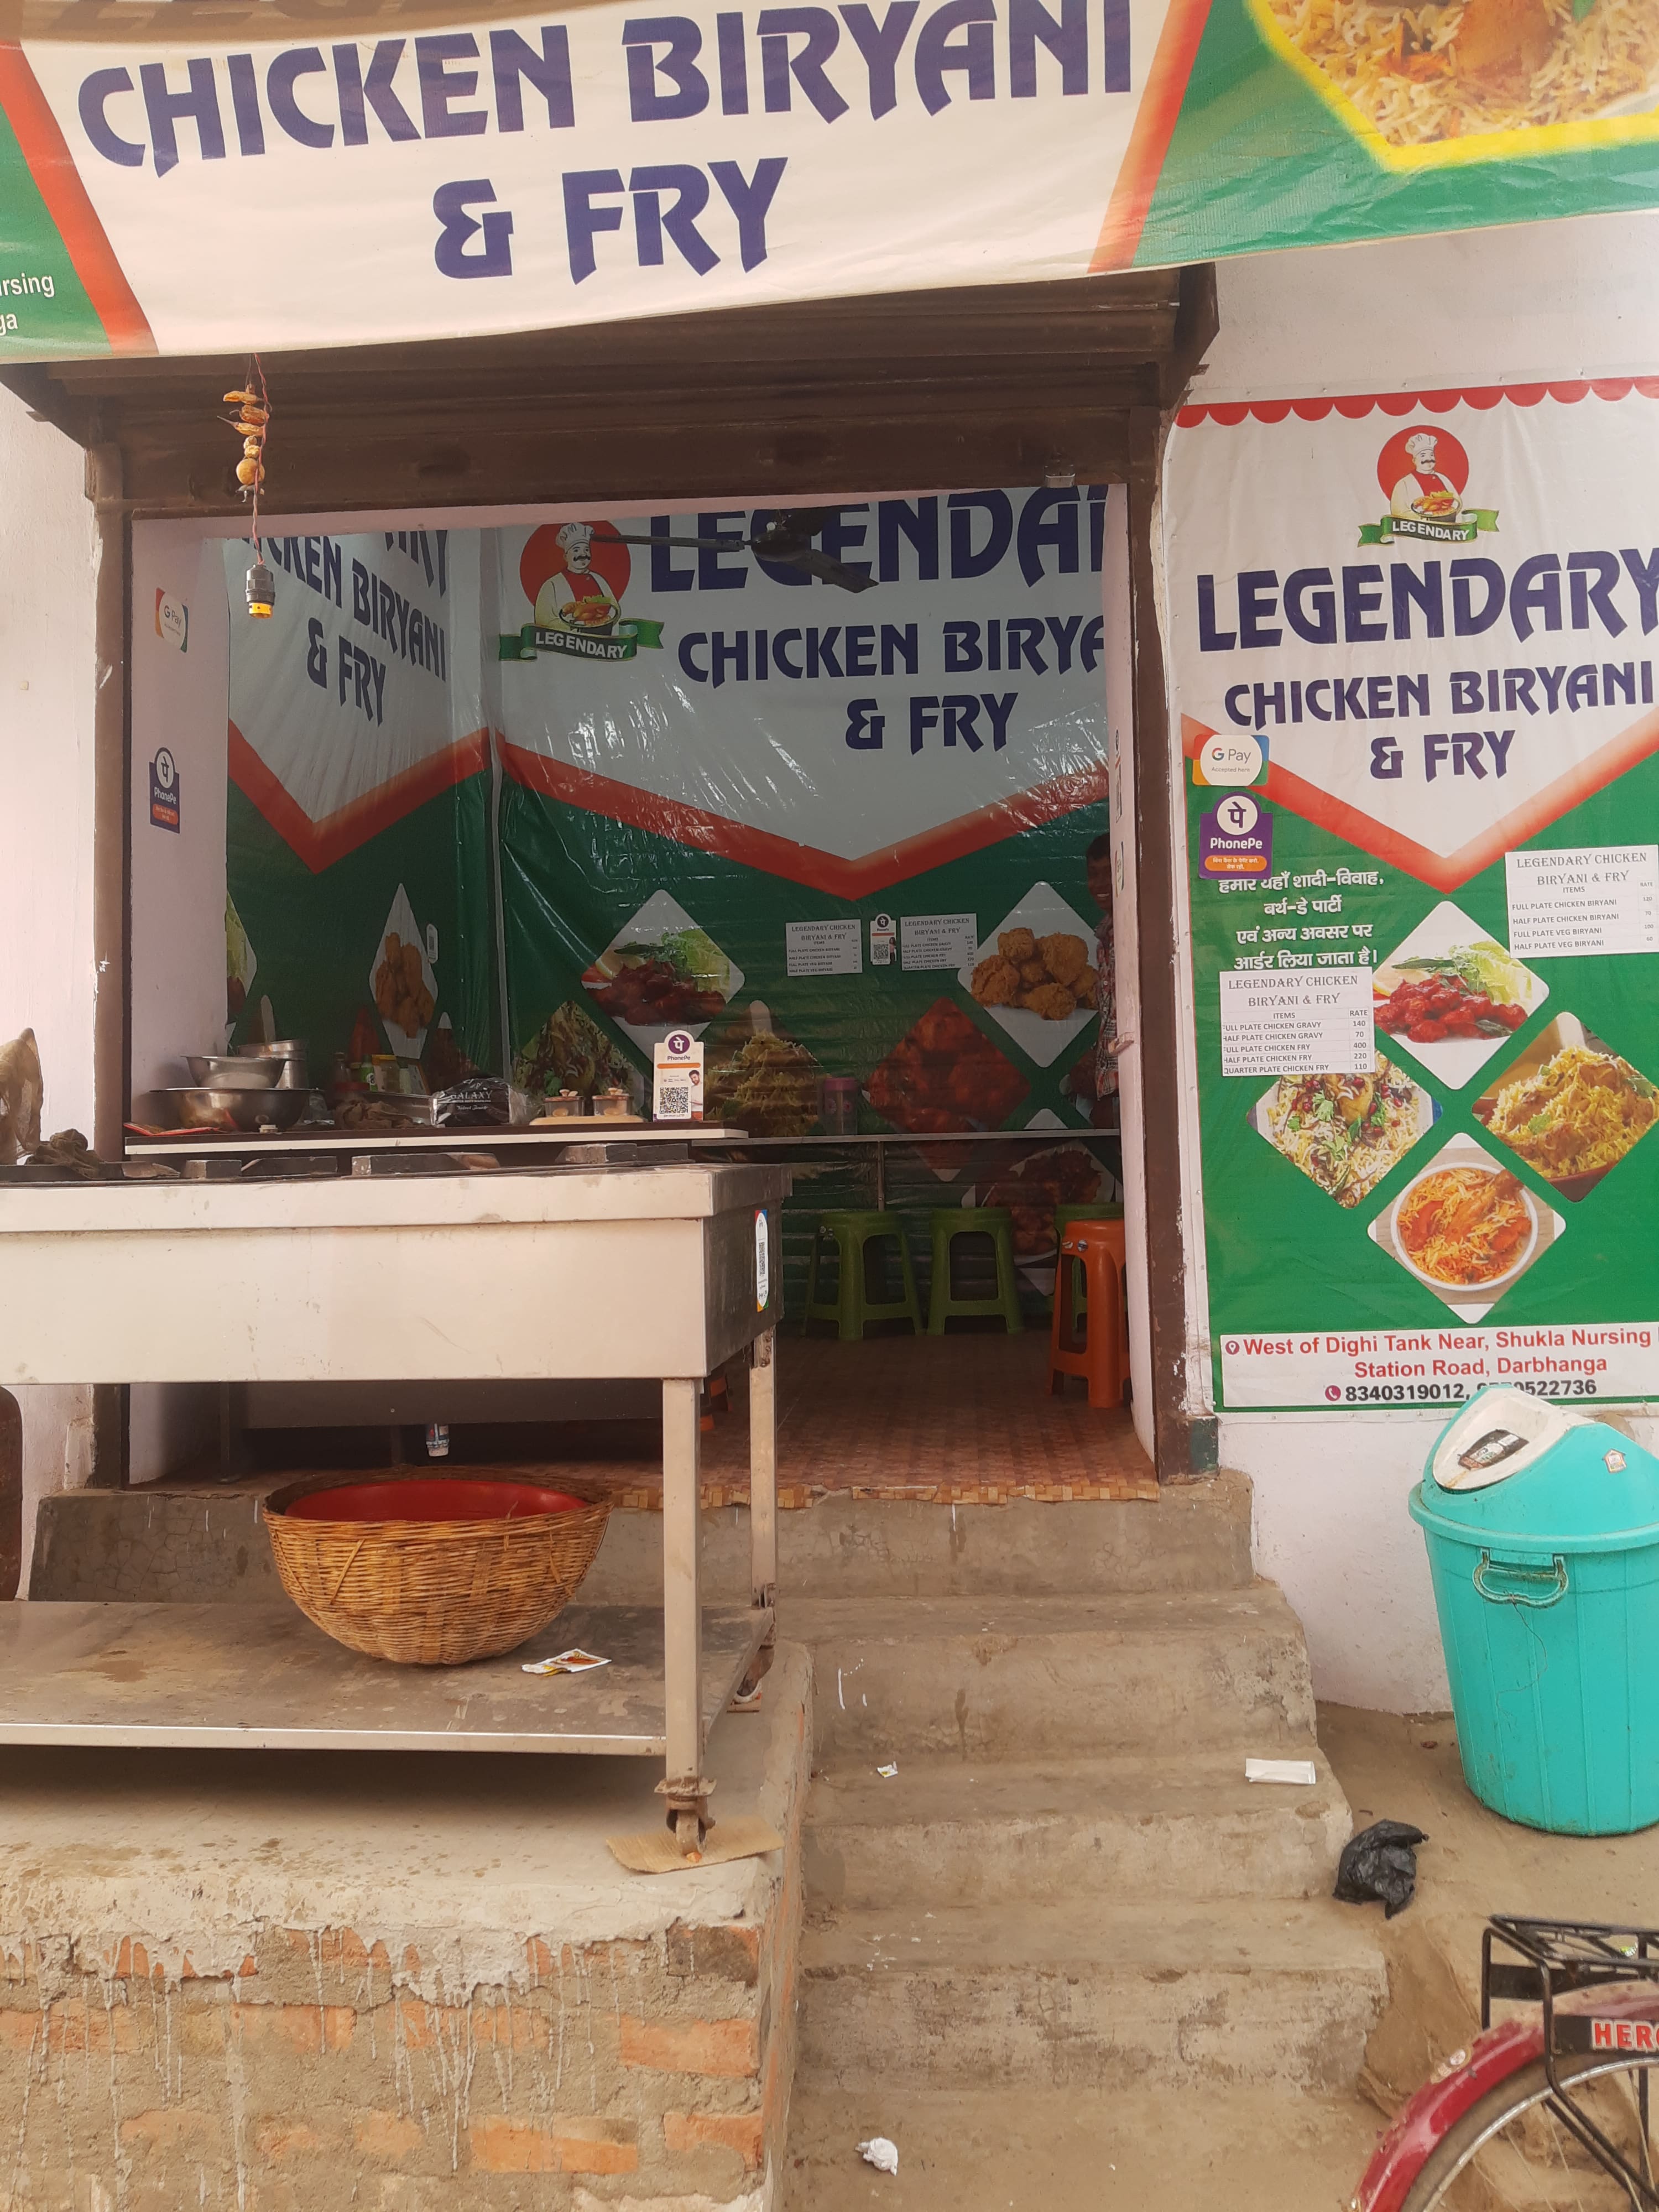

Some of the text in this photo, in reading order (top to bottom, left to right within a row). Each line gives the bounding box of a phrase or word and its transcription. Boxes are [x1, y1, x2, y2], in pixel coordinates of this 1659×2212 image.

[78, 0, 1131, 178] CHICKEN BIRYANI
[432, 156, 789, 284] & FRY
[0, 273, 55, 298] rsing
[1392, 520, 1470, 541] LEGENDARY
[1197, 547, 1659, 652] LEGENDARY
[171, 610, 181, 629] Pay
[352, 557, 446, 682] BIRYANI
[535, 632, 628, 659] LEGENDARY
[678, 623, 919, 689] CHICKEN
[307, 617, 387, 727] & FRY
[1224, 661, 1653, 731] CHICKEN BIRYANI
[845, 692, 1019, 755] & FRY
[1212, 748, 1251, 764] G Pay
[1370, 730, 1516, 782] & FRY
[154, 786, 176, 805] PhonePe
[1227, 801, 1246, 828] पे
[1210, 837, 1262, 849] PhonePe
[1517, 852, 1647, 868] LEGENDARY CHICKEN
[1537, 870, 1630, 885] BIRYANI & FRY
[1312, 894, 1342, 913] पार्टी
[905, 918, 942, 927] LEGENDARY
[1236, 924, 1374, 945] एवं अन्य अवसर पर
[1234, 951, 1275, 969] आर्डर
[1277, 950, 1313, 968] लिया
[1316, 951, 1355, 965] जाता
[1228, 975, 1358, 989] LEGENDARY CHICKEN
[1248, 993, 1340, 1006] BIRYANI & FRY
[673, 1037, 685, 1051] पे
[1243, 1339, 1293, 1355] West
[1300, 1337, 1319, 1354] of
[1326, 1336, 1378, 1357] Dighi
[1384, 1334, 1432, 1352] Tank
[1438, 1333, 1489, 1352] Near,
[1496, 1330, 1565, 1348] Shukla
[1572, 1328, 1651, 1348] Nursing
[1354, 1356, 1608, 1378] Station Road, Darbhanga
[1345, 1383, 1470, 1402] 8340319012,
[1593, 2021, 1659, 2049] HER
